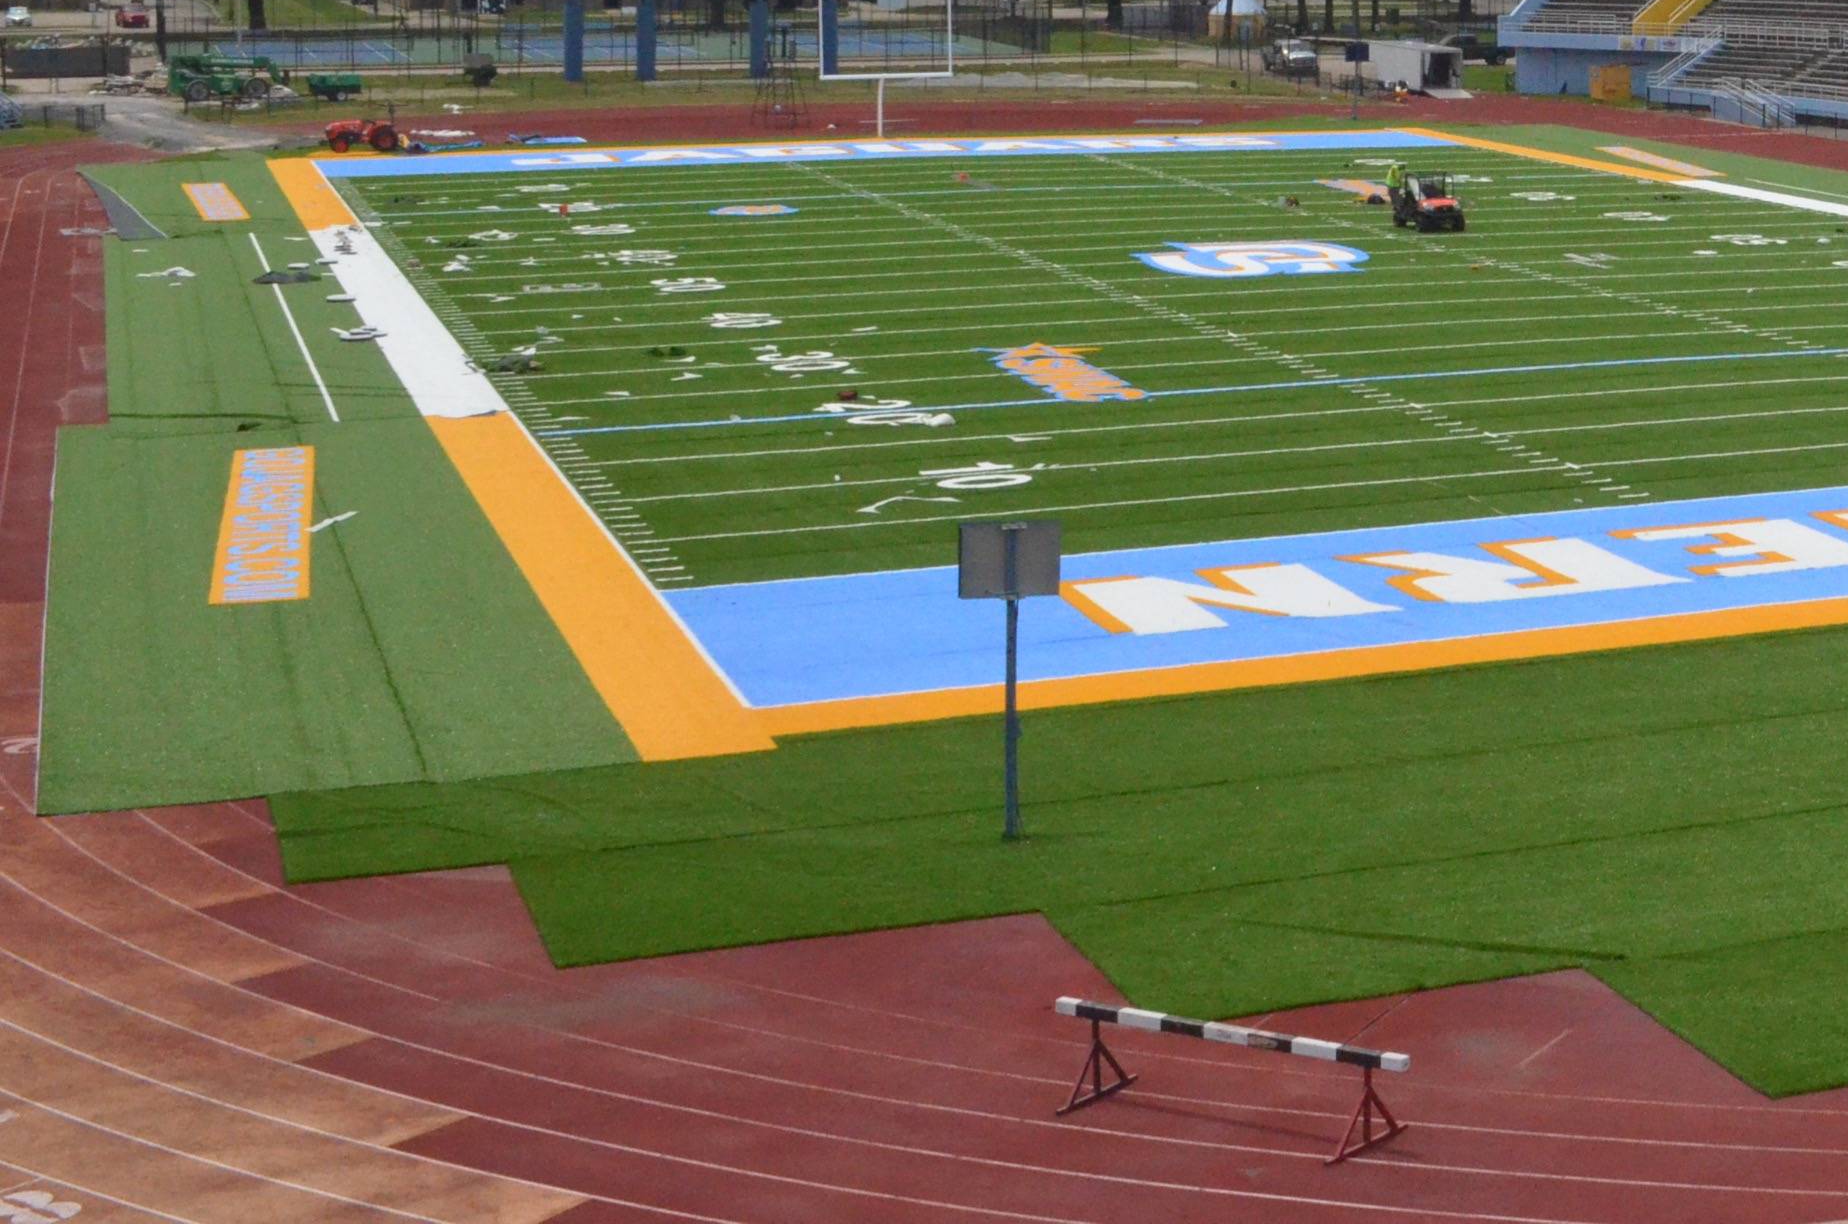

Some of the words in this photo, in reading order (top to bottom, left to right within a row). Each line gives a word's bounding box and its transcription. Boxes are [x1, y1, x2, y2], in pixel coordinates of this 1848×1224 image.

[511, 137, 1278, 166] JAGUARS
[756, 350, 851, 372] 30
[813, 398, 940, 427] 20
[919, 460, 1033, 490] 10
